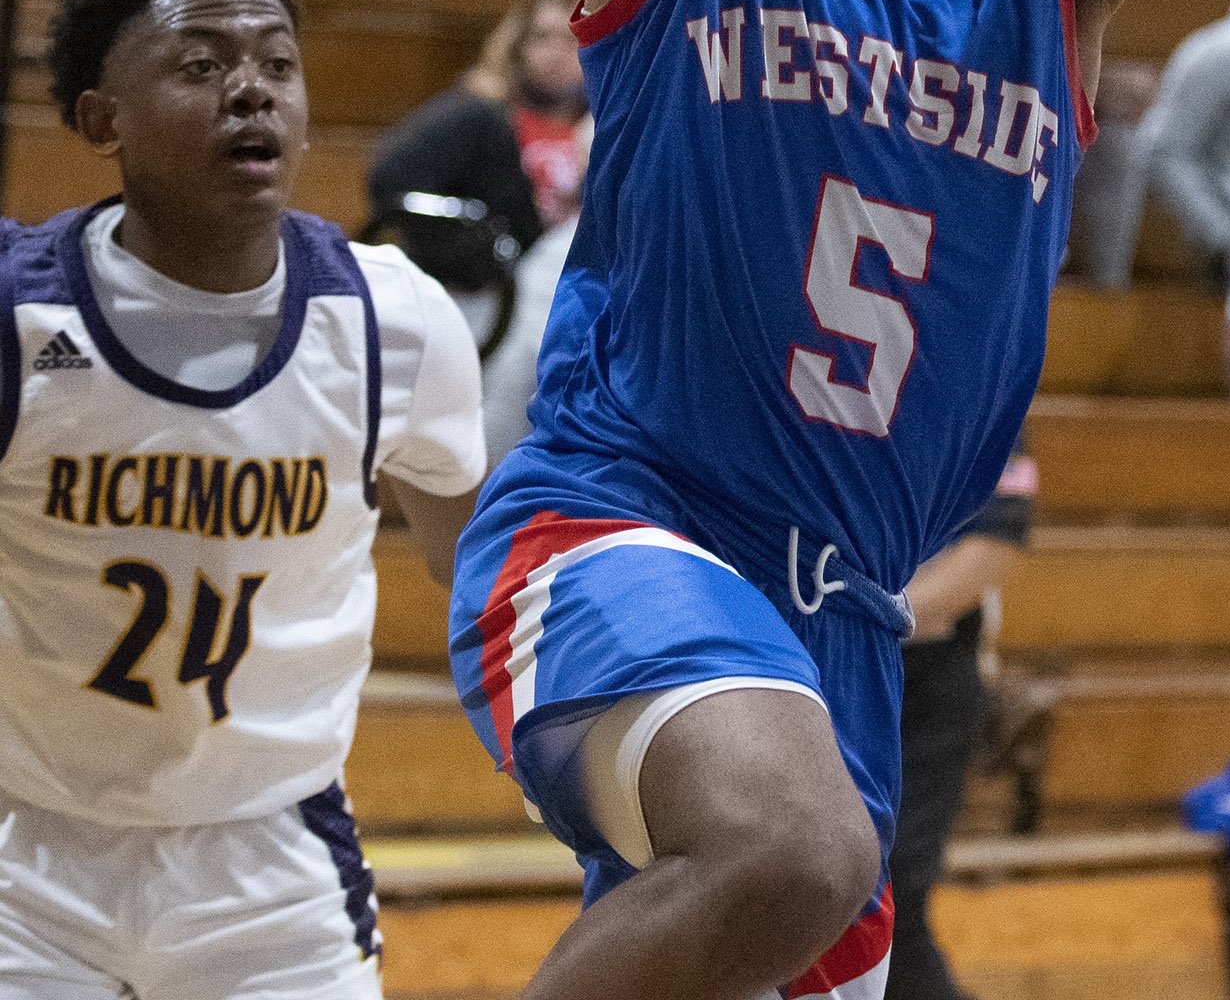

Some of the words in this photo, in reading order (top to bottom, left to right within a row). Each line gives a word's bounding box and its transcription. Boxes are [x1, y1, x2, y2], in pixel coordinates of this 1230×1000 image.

[687, 6, 1058, 202] WESTSIDE
[33, 354, 93, 371] adidas
[787, 173, 935, 438] 5
[44, 452, 329, 539] RICHMOND
[81, 557, 270, 726] 24
